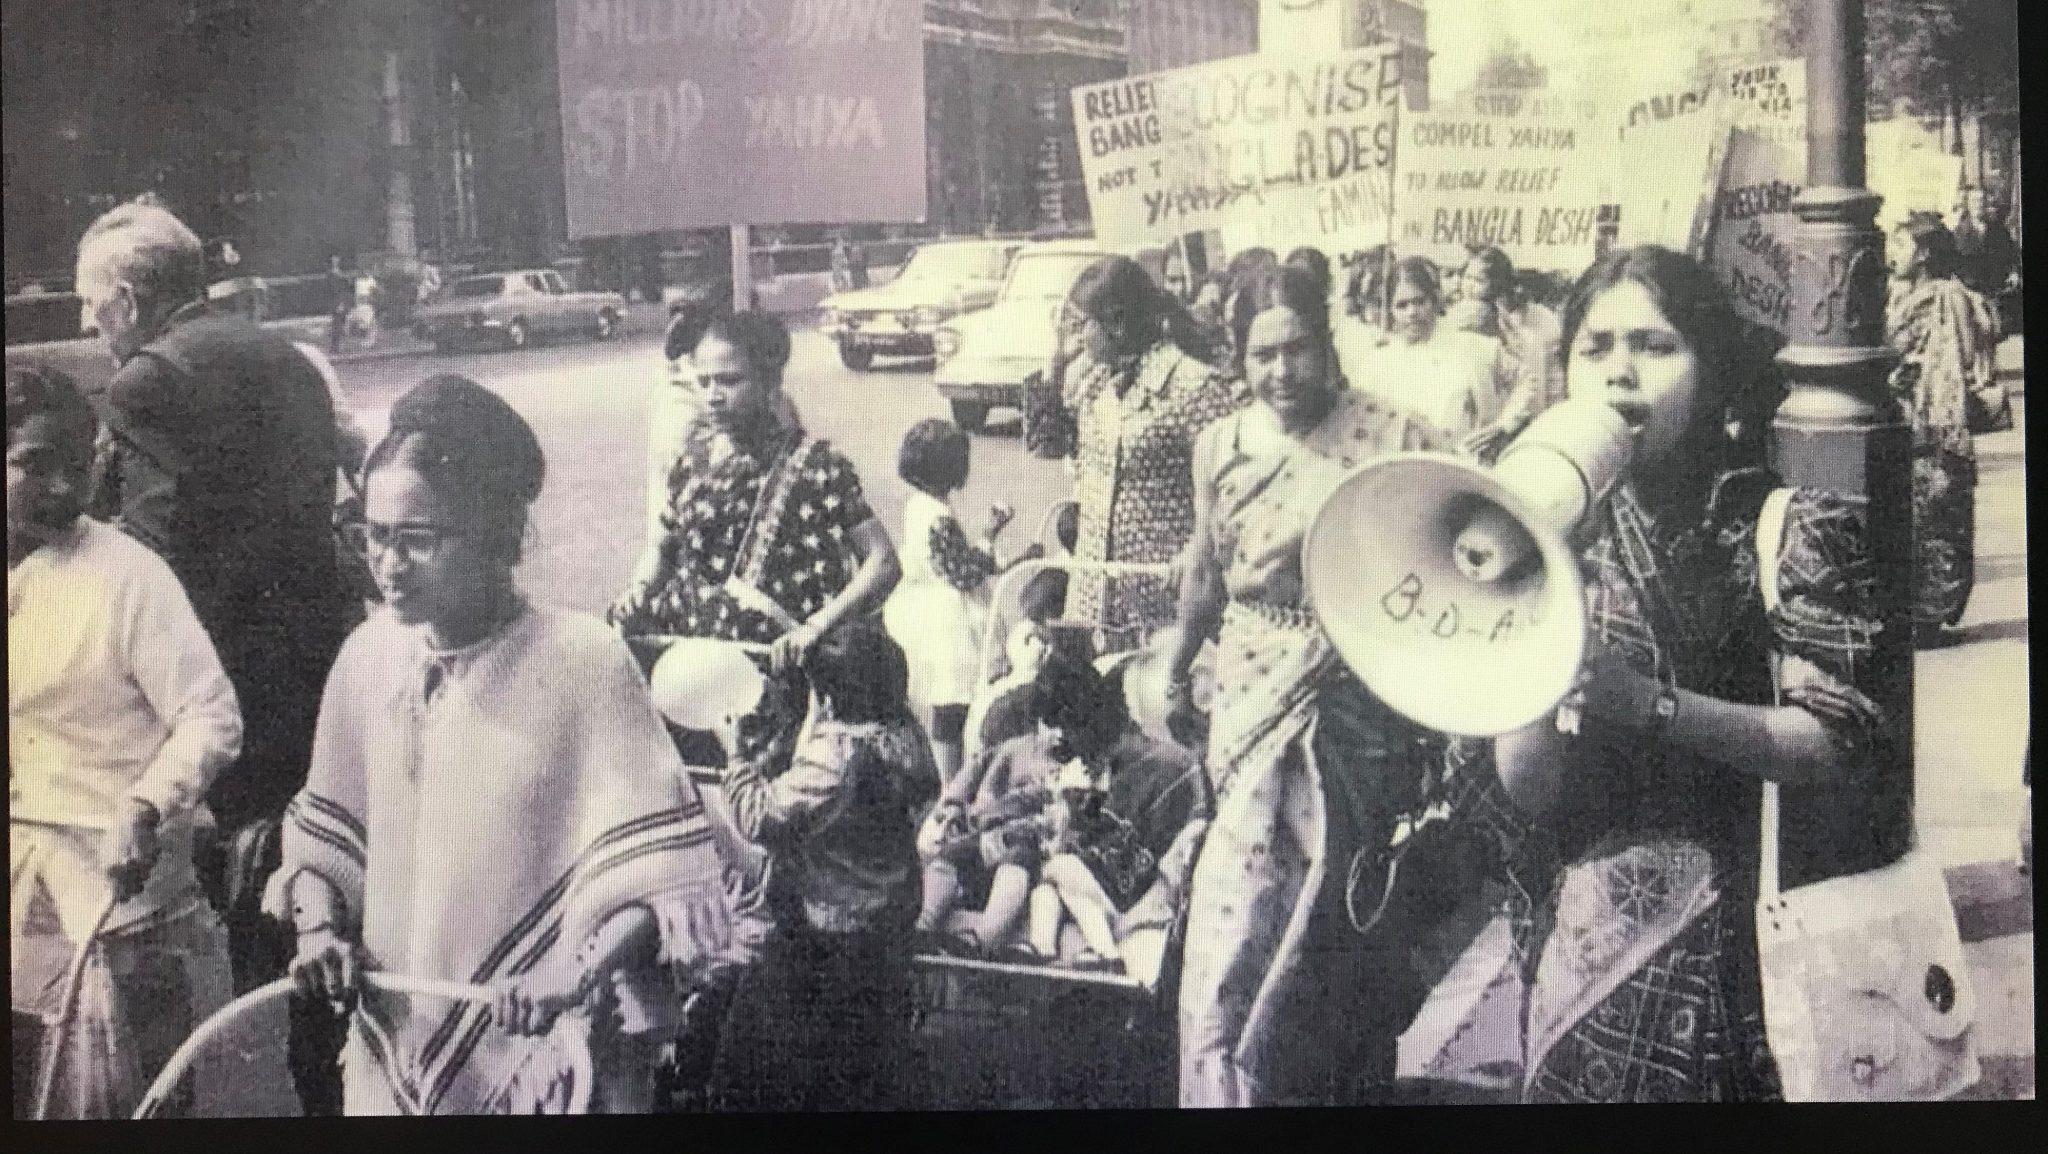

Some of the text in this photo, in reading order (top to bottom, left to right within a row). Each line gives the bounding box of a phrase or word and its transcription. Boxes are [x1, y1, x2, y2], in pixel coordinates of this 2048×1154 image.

[572, 78, 704, 182] STOP
[1412, 120, 1496, 149] COMPEL
[1494, 164, 1563, 194] RELIEF
[1432, 204, 1524, 246] BANGLA
[1533, 202, 1598, 247] DESH
